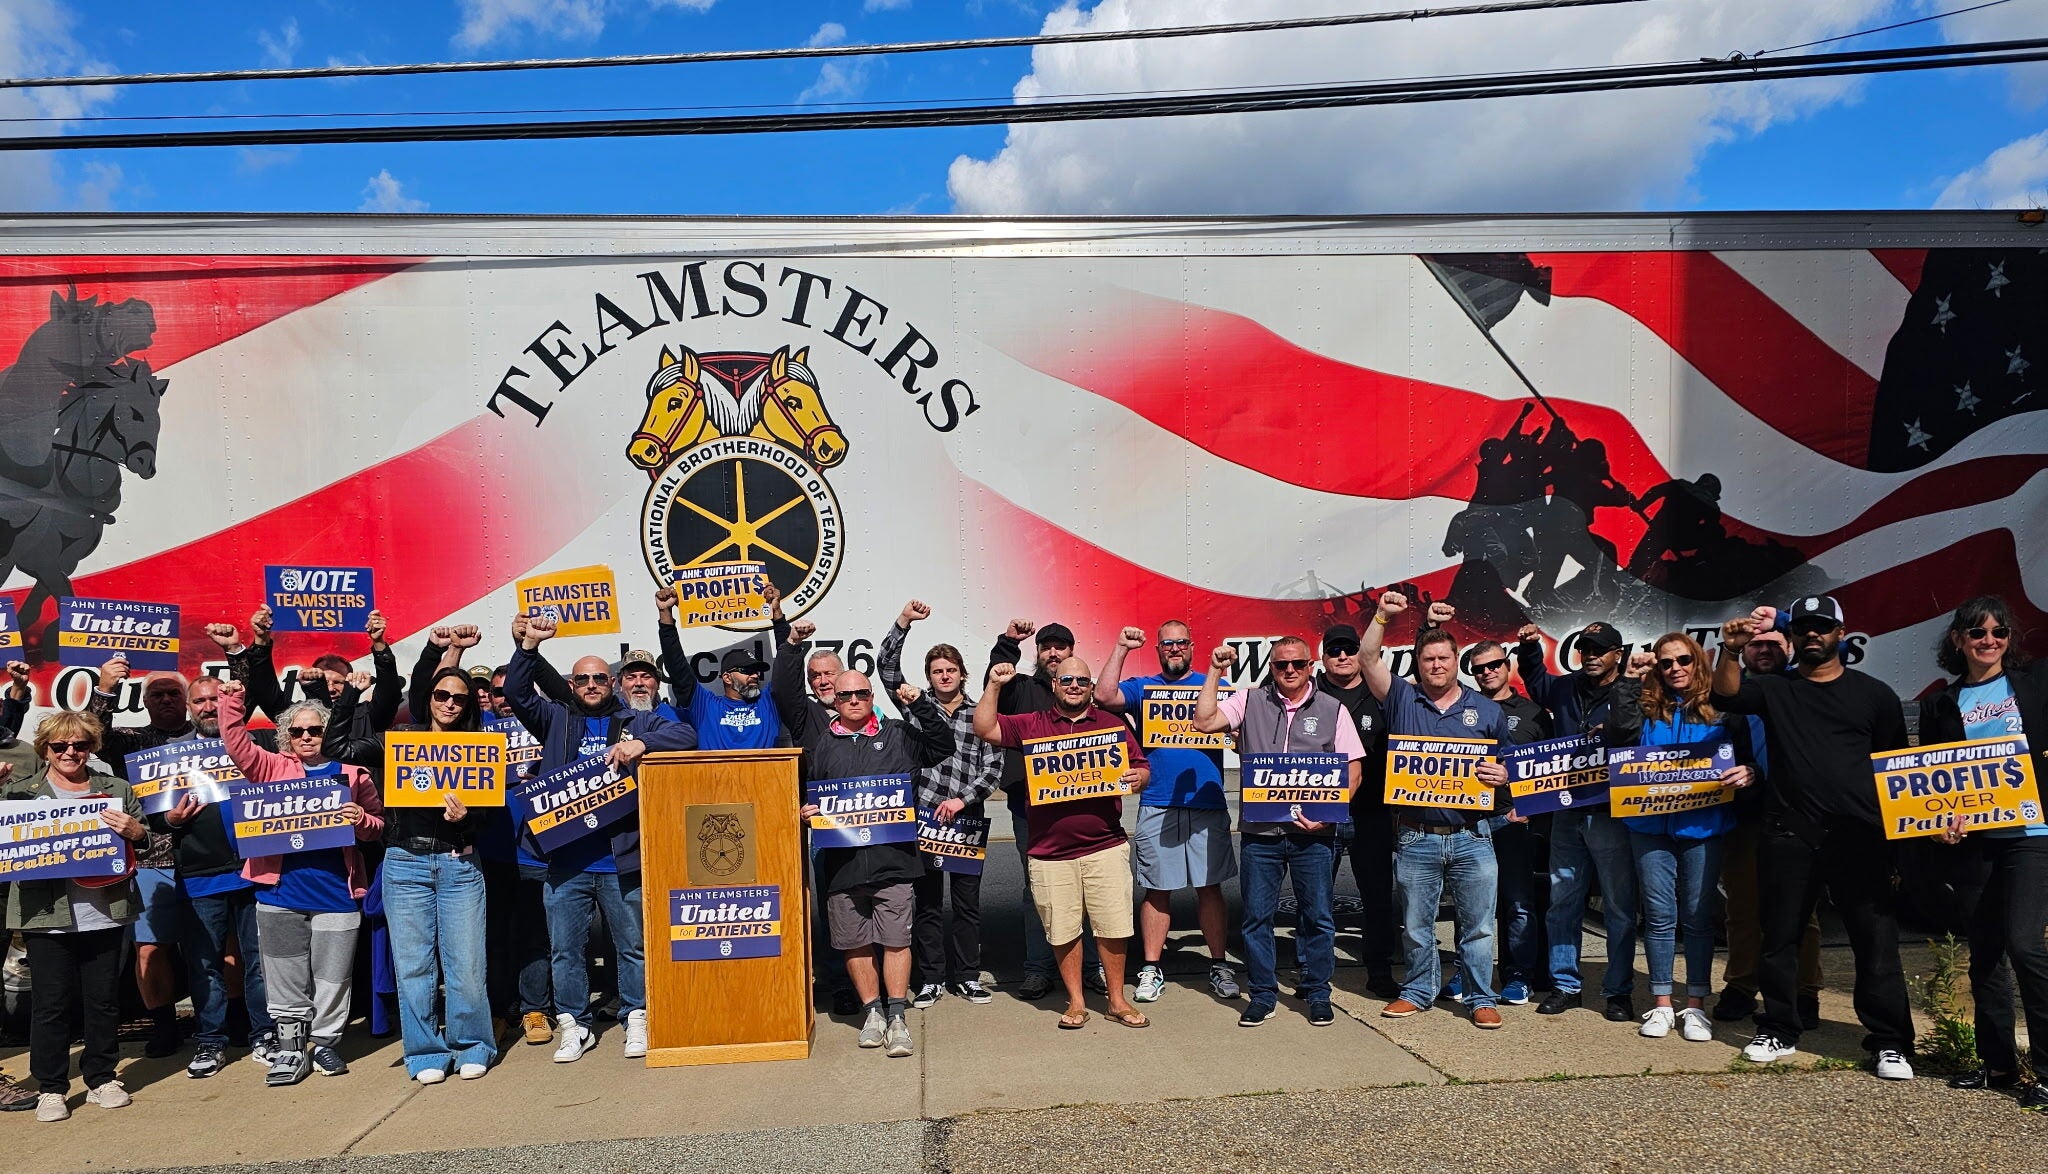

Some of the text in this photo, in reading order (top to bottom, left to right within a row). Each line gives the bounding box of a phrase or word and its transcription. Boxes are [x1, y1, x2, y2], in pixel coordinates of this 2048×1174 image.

[486, 261, 981, 432] TEAMSTERS
[650, 440, 836, 607] ERNATIONAL BROTHERHOOD OF TEAMSTERS
[297, 570, 358, 592] VOTE
[682, 564, 760, 580] AHN: QUIT PUTTING
[523, 582, 611, 603] TEAMSTER
[682, 574, 764, 600] PROFIT$
[71, 601, 170, 614] AHN TEAMSTERS
[273, 593, 366, 608] TEAMSTERS
[705, 597, 747, 610] OVER
[297, 609, 343, 628] YES!
[528, 600, 610, 624] PWER
[687, 607, 759, 624] Patients
[70, 612, 171, 636] United
[69, 635, 170, 650] for PATIENTS
[1151, 690, 1170, 700] AHN:
[1172, 690, 1193, 700] QUIT
[1149, 703, 1196, 720] PROF
[1168, 723, 1197, 732] OVE
[1032, 733, 1118, 754] AHN: QUIT PUTTING
[1149, 733, 1220, 745] Patients
[1396, 741, 1489, 755] AHN: QUIT PUTTING
[1513, 735, 1601, 757] AHN TEAMSTERS
[136, 741, 226, 762] AHN TEAMSTER
[391, 744, 500, 763] TEAMSTER
[1032, 745, 1123, 776] PROFIT$
[1252, 757, 1339, 765] AHN TEAMSTERS
[1608, 749, 1691, 765] AHN: STOP
[1886, 743, 2016, 771] AHN: QUIT PUTTING
[1516, 747, 1607, 779] United
[1619, 757, 1713, 775] ATTACKING
[141, 768, 241, 794] for PATNTS
[396, 766, 495, 791] PWER
[817, 778, 902, 792] AHN TEAMSTERS
[1056, 771, 1103, 785] OVER
[1253, 768, 1341, 787] United
[1415, 778, 1464, 791] OVER
[1519, 768, 1610, 793] for PATIENTS
[1638, 768, 1723, 784] Workers
[1887, 758, 2025, 800] PROFIT$
[240, 778, 338, 797] AHN TEAMSTERS
[525, 780, 547, 795] AHN
[530, 764, 620, 814] United
[1038, 781, 1115, 801] Patients
[1252, 790, 1341, 801] for PATIENTS
[1392, 788, 1476, 805] Patients
[1622, 788, 1723, 806] ABANDONING
[1648, 784, 1693, 795] STOP
[50, 806, 76, 818] OFF
[79, 802, 109, 815] OUR
[243, 790, 343, 820] United
[540, 782, 627, 828] for PATIENTS
[818, 789, 906, 816] United
[1639, 796, 1722, 813] Patients
[1925, 793, 1996, 812] OVER
[244, 813, 344, 834] for PATIENTS
[835, 810, 907, 826] PATIENTS
[918, 809, 931, 819] HN
[11, 819, 100, 842] Union
[52, 838, 80, 851] OFF
[82, 834, 112, 846] OUR
[0, 846, 118, 874] Health Care
[679, 889, 770, 901] AHN TEAMSTERS
[680, 901, 772, 924] United
[679, 923, 772, 938] for PATIENTS
